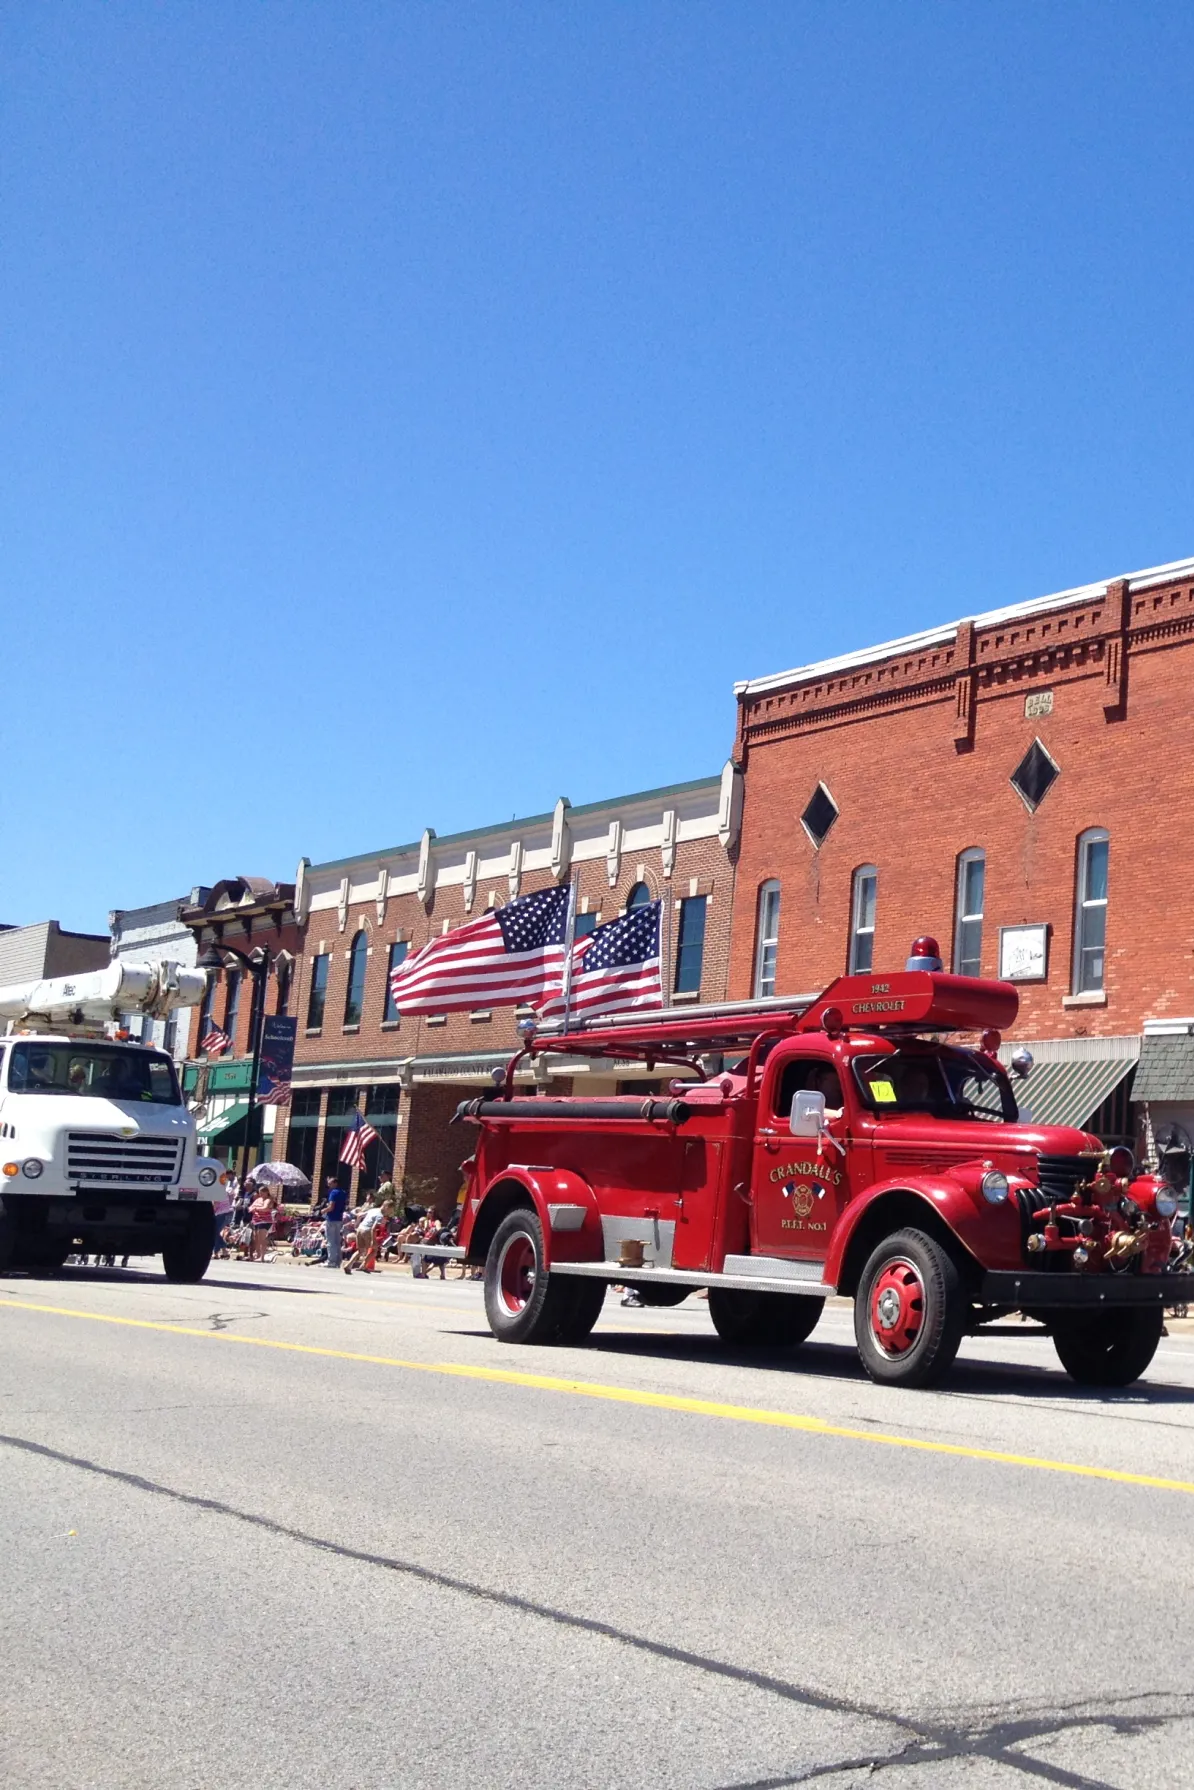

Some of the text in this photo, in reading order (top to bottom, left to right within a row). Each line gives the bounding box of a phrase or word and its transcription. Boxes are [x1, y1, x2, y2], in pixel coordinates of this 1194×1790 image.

[871, 983, 890, 994] 1942
[852, 1000, 905, 1014] CHEVROLET
[81, 1172, 162, 1183] STERLING
[770, 1161, 842, 1186] CRANDALL'S
